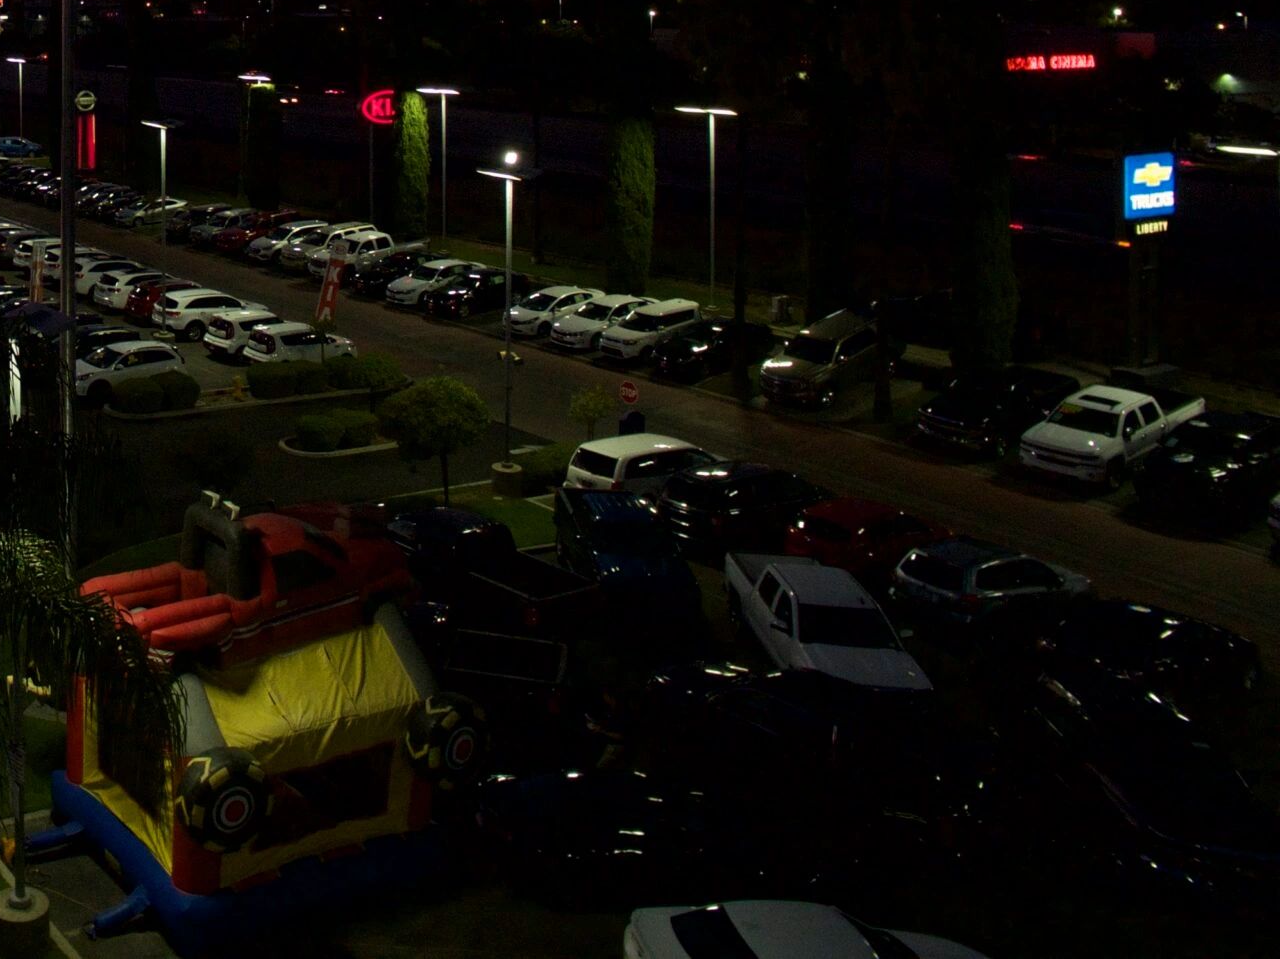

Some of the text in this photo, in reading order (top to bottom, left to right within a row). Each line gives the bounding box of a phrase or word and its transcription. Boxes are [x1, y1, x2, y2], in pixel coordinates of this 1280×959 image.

[1050, 54, 1095, 69] CINEMA
[1130, 191, 1175, 210] TRUCKS
[1136, 221, 1168, 235] LIBERTY
